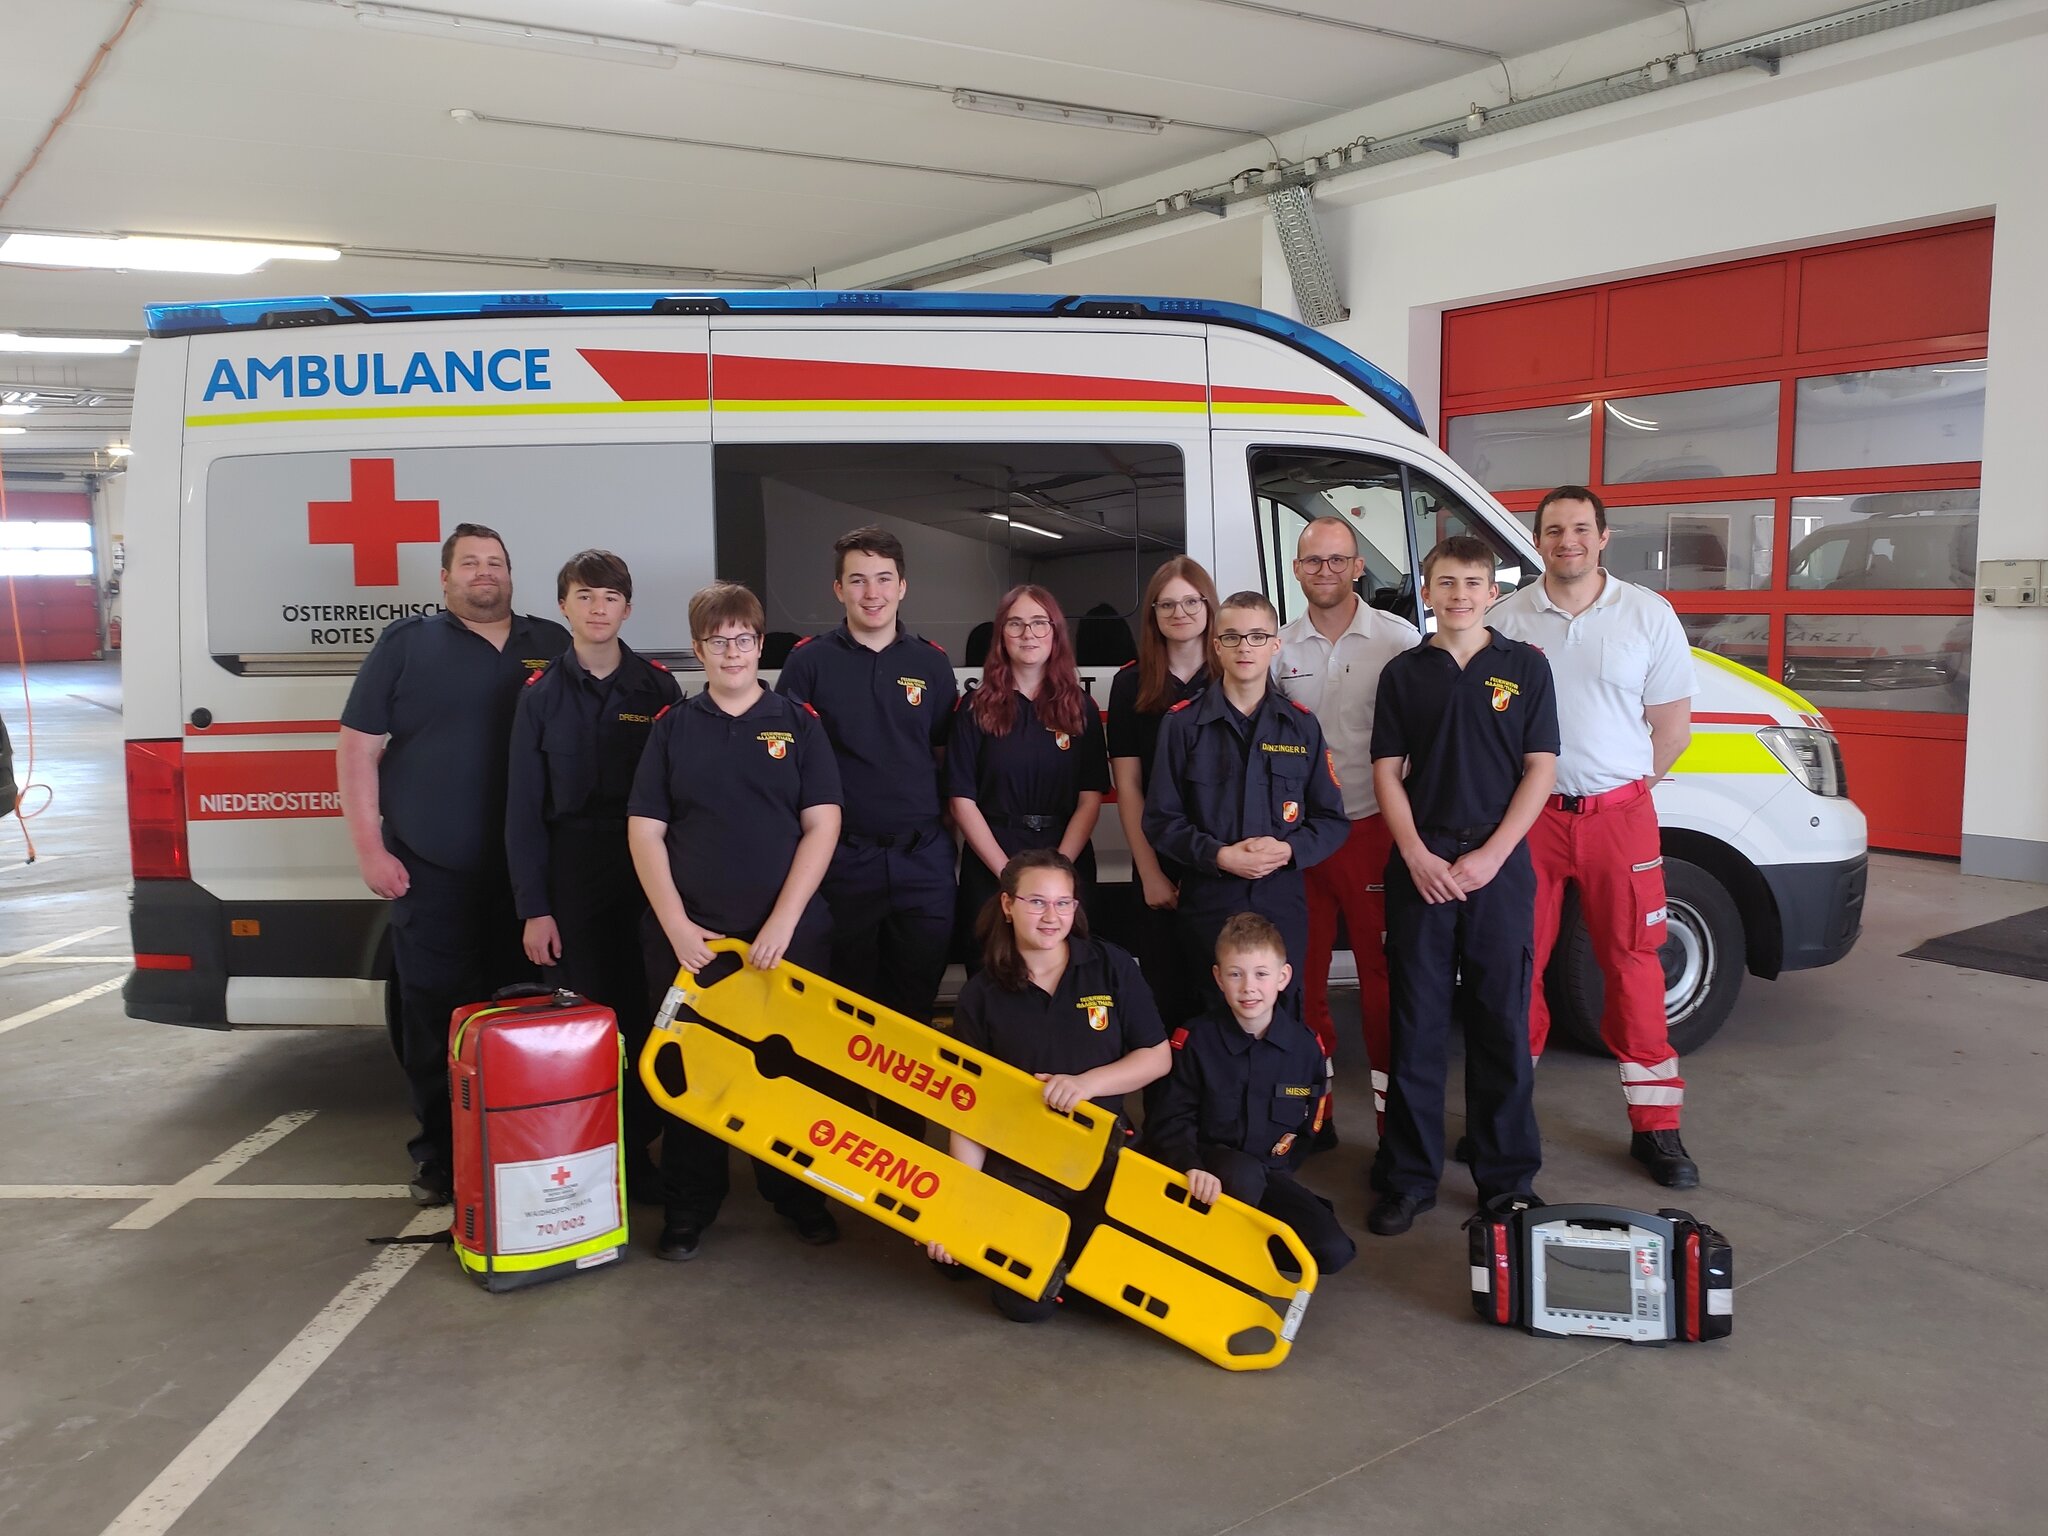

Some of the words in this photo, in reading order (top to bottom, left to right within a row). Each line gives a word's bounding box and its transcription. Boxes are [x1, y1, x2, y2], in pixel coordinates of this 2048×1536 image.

[202, 348, 551, 402] AMBULANCE
[311, 627, 375, 645] ROTES
[847, 1034, 953, 1101] FERNO
[829, 1130, 941, 1199] FERNO
